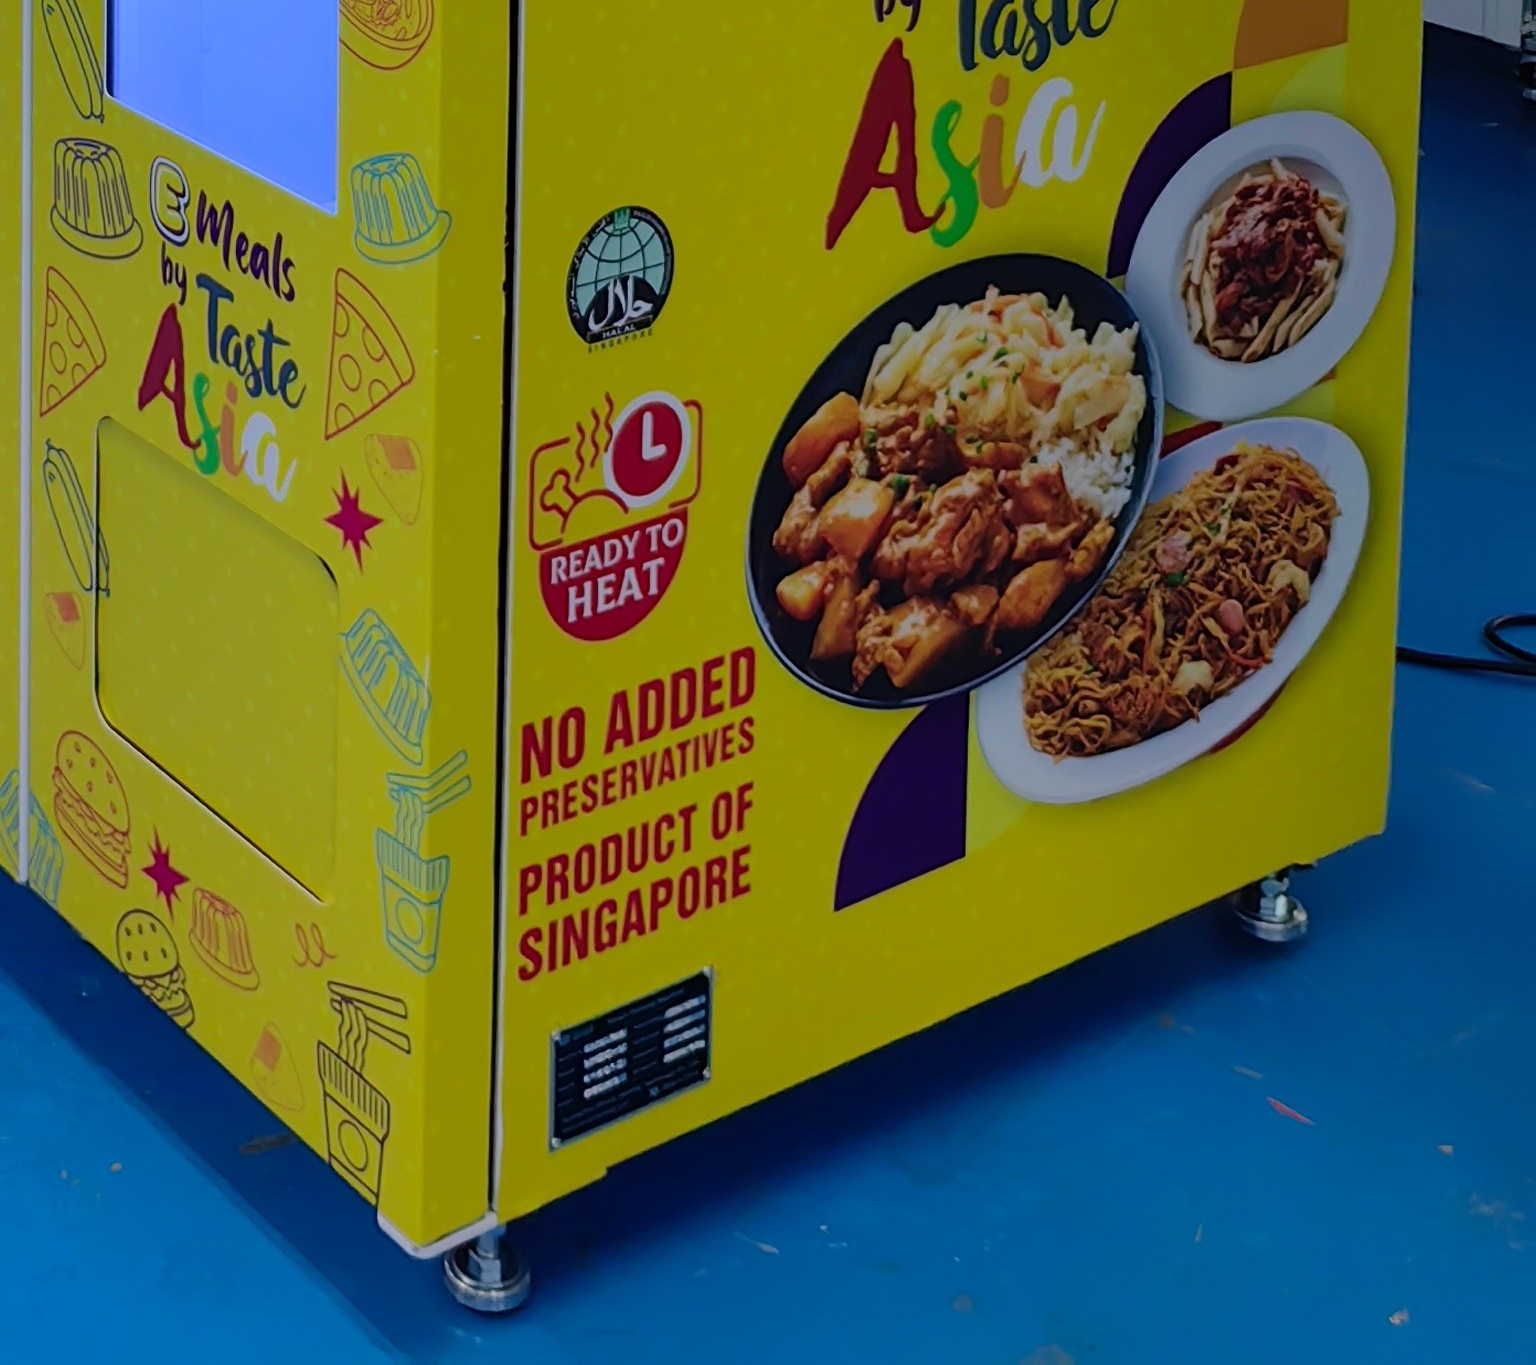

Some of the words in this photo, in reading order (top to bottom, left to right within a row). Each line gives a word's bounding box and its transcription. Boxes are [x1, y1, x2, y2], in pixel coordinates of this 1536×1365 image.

[824, 37, 1107, 250] Asia
[197, 189, 297, 302] Meals
[161, 241, 187, 305] by
[196, 274, 307, 409] Taste
[138, 302, 297, 503] Asia
[549, 535, 639, 587] READY
[643, 519, 686, 558] TO
[565, 562, 670, 624] HEAT
[519, 716, 756, 837] PRESERVATIVES
[520, 706, 586, 785] NO
[604, 646, 757, 756] ADDED
[518, 806, 697, 917] PRODUCT
[711, 783, 754, 834] OF
[518, 846, 752, 983] SINGAPORE
